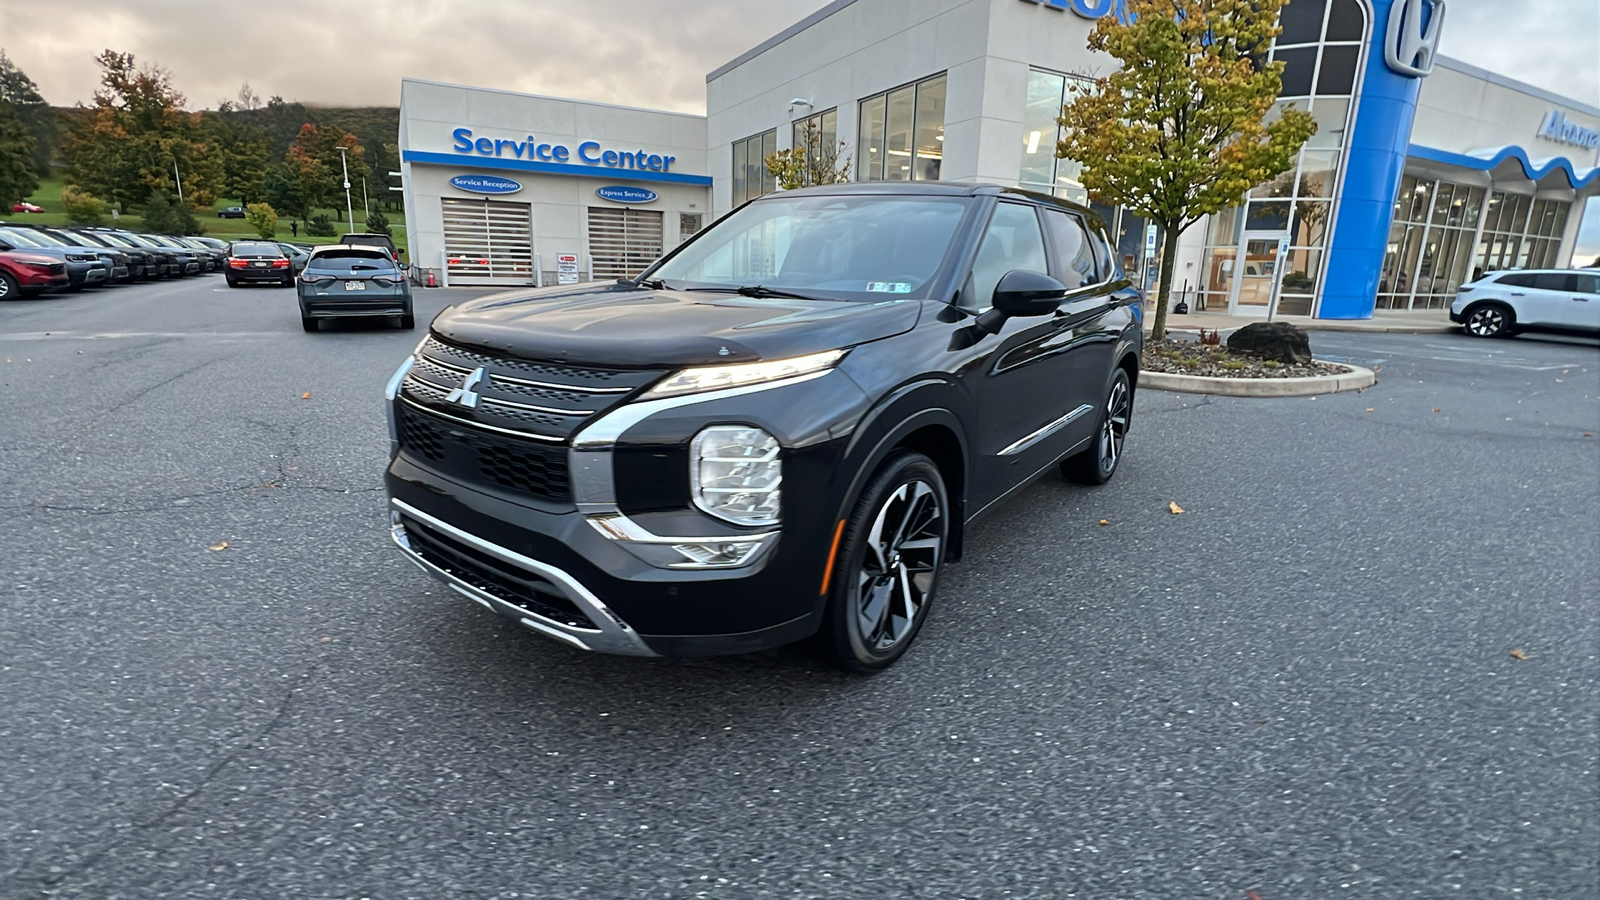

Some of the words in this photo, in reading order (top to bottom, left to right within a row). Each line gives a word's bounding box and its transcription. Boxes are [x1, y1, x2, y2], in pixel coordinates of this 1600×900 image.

[452, 128, 569, 162] Service
[578, 141, 676, 171] Center
[454, 177, 481, 186] Service
[482, 180, 518, 189] Reception
[600, 189, 623, 197] Express
[624, 190, 646, 198] Service
